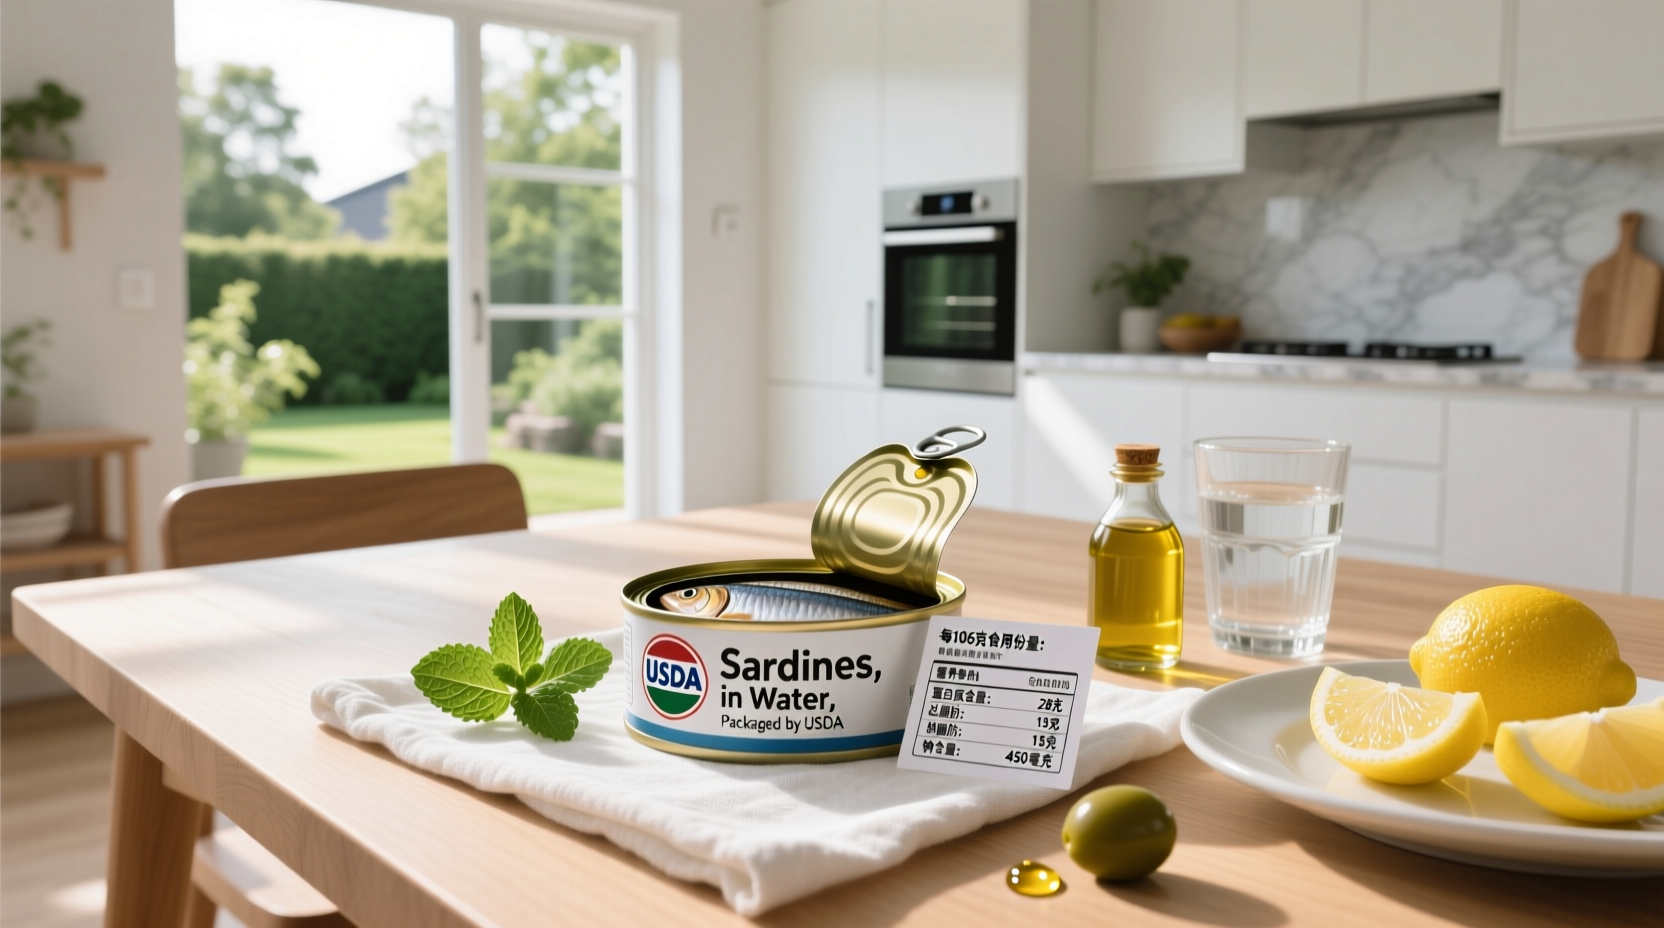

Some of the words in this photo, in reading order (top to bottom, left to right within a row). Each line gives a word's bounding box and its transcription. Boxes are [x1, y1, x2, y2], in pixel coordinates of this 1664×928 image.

[646, 658, 702, 692] USDA
[720, 647, 882, 683] Sardines,
[720, 685, 742, 708] in
[749, 687, 836, 713] Water,
[721, 715, 781, 733] Packaged
[785, 716, 801, 734] by
[804, 716, 844, 730] USDA
